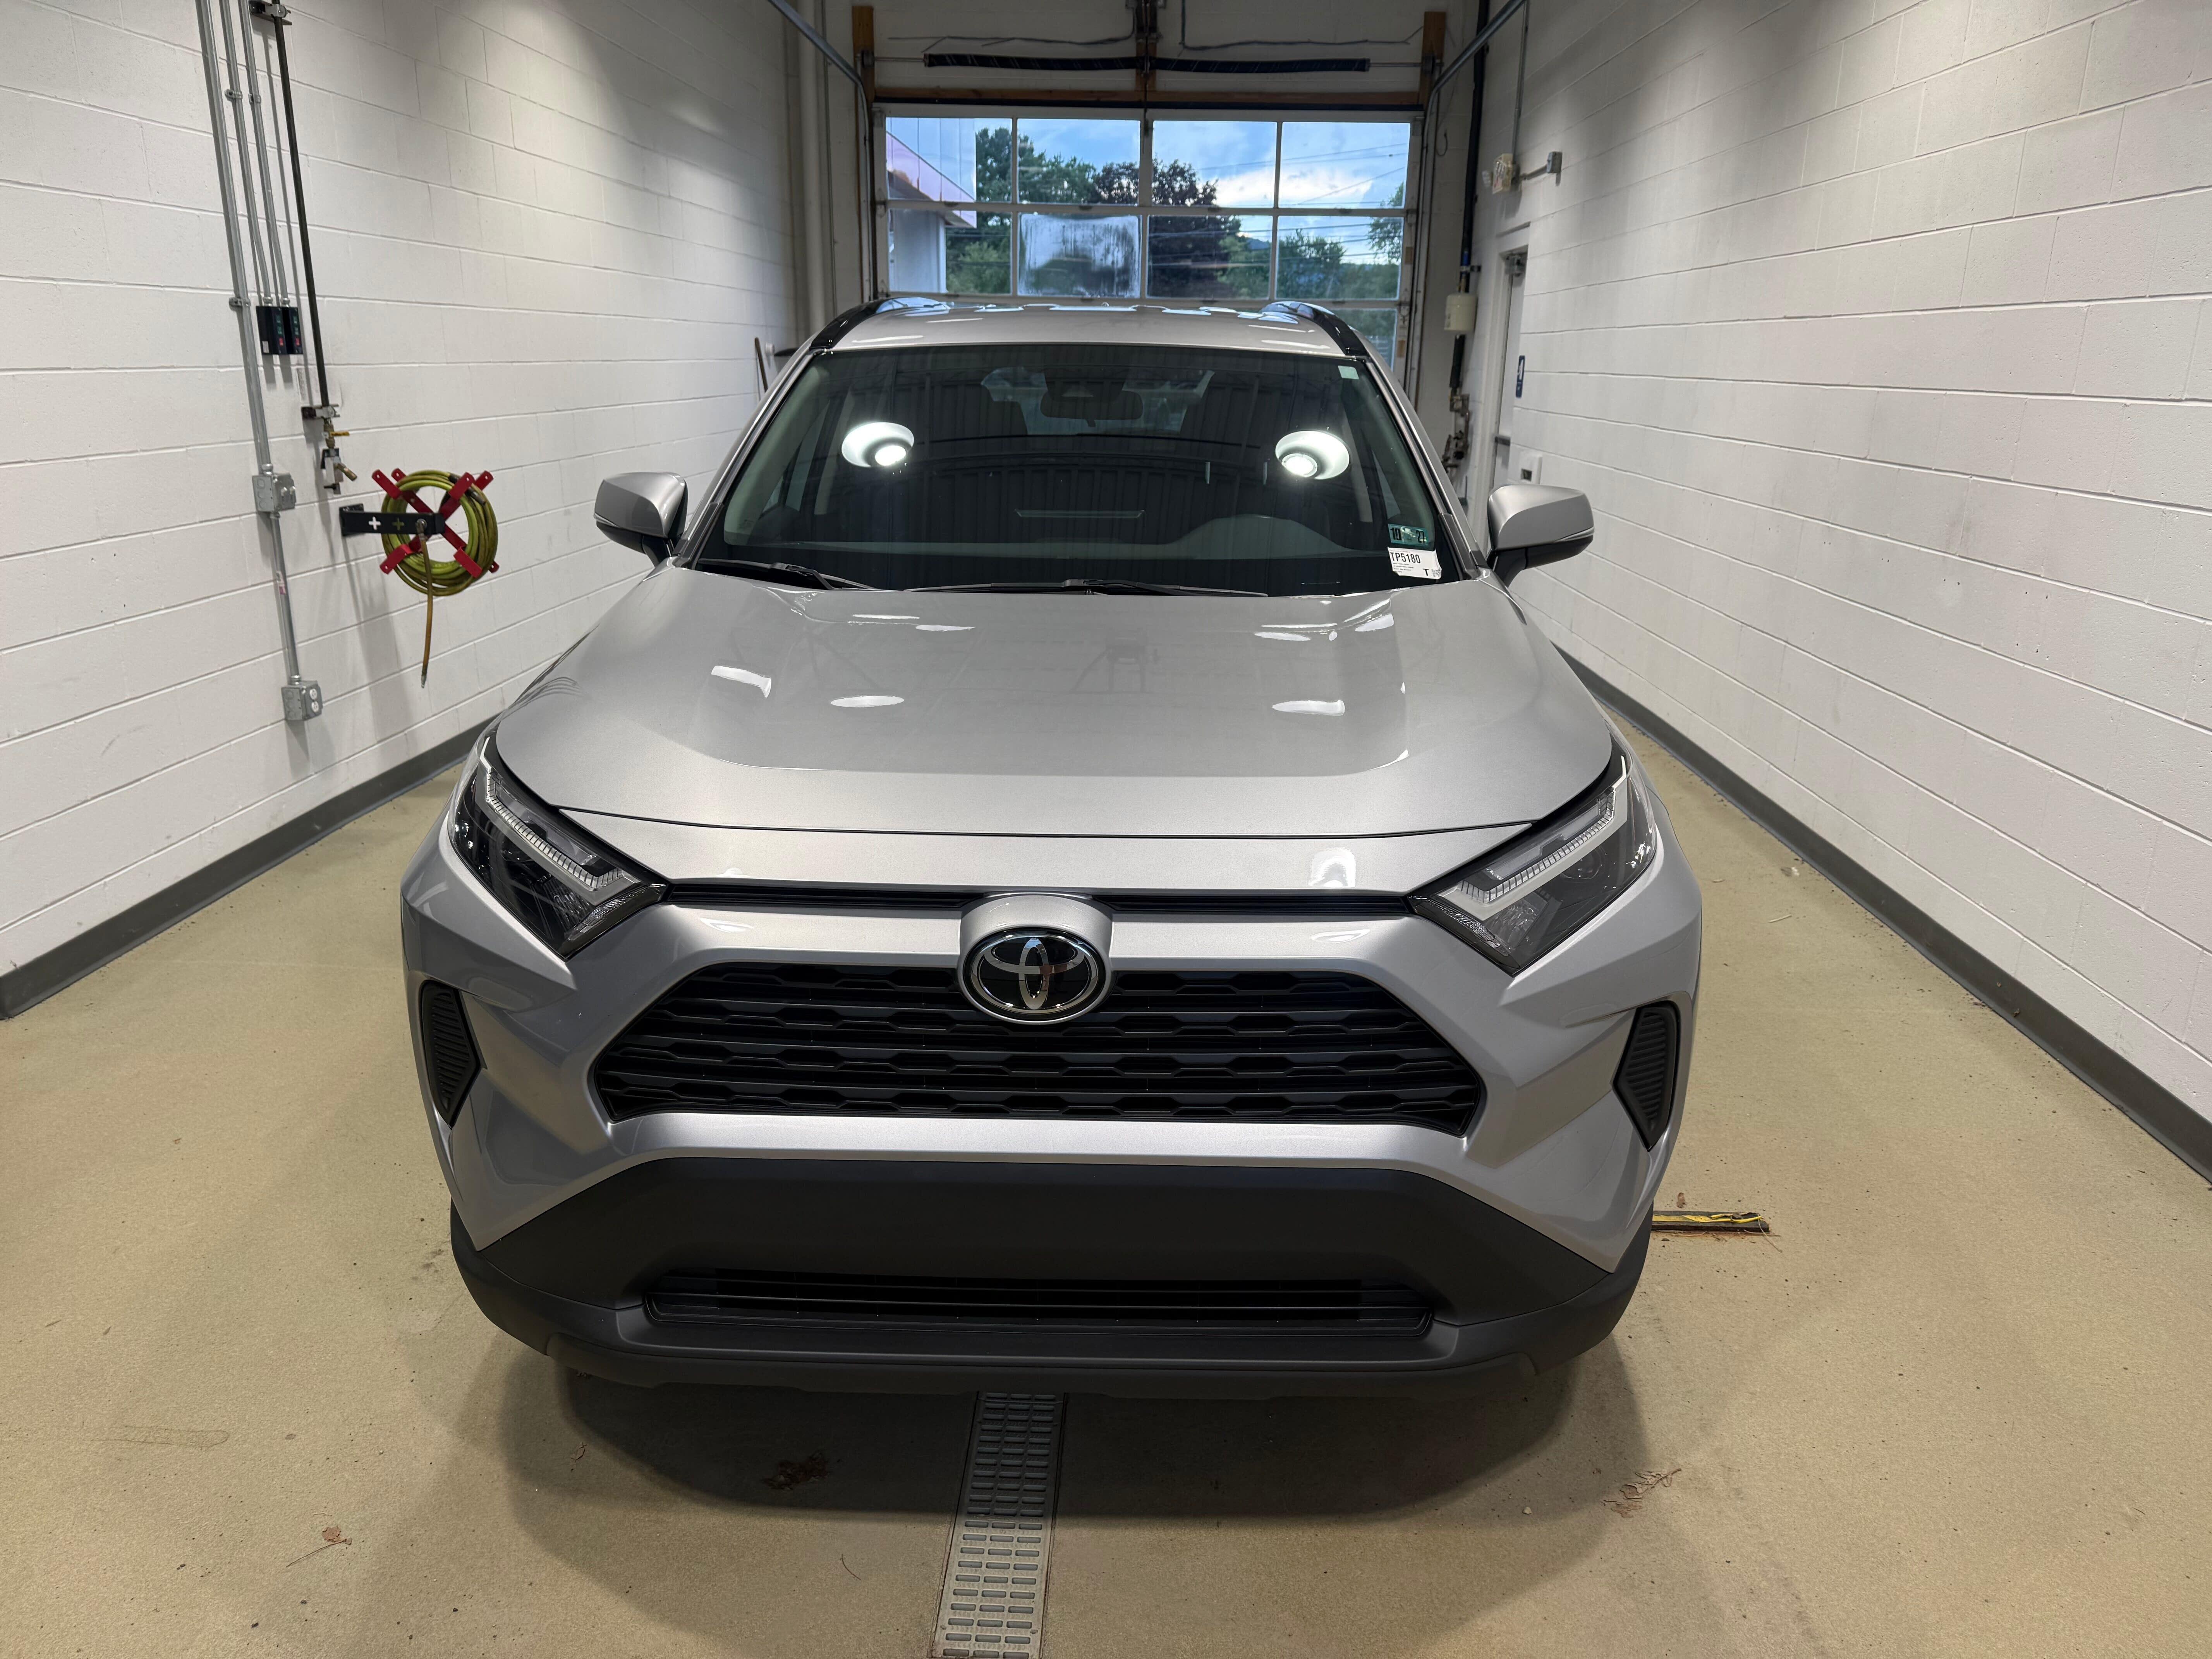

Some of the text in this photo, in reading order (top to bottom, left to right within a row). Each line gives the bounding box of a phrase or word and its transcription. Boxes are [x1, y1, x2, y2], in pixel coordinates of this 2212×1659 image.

[1390, 528, 1402, 541] 10
[1390, 552, 1421, 563] TP5180
[1422, 568, 1429, 576] T
